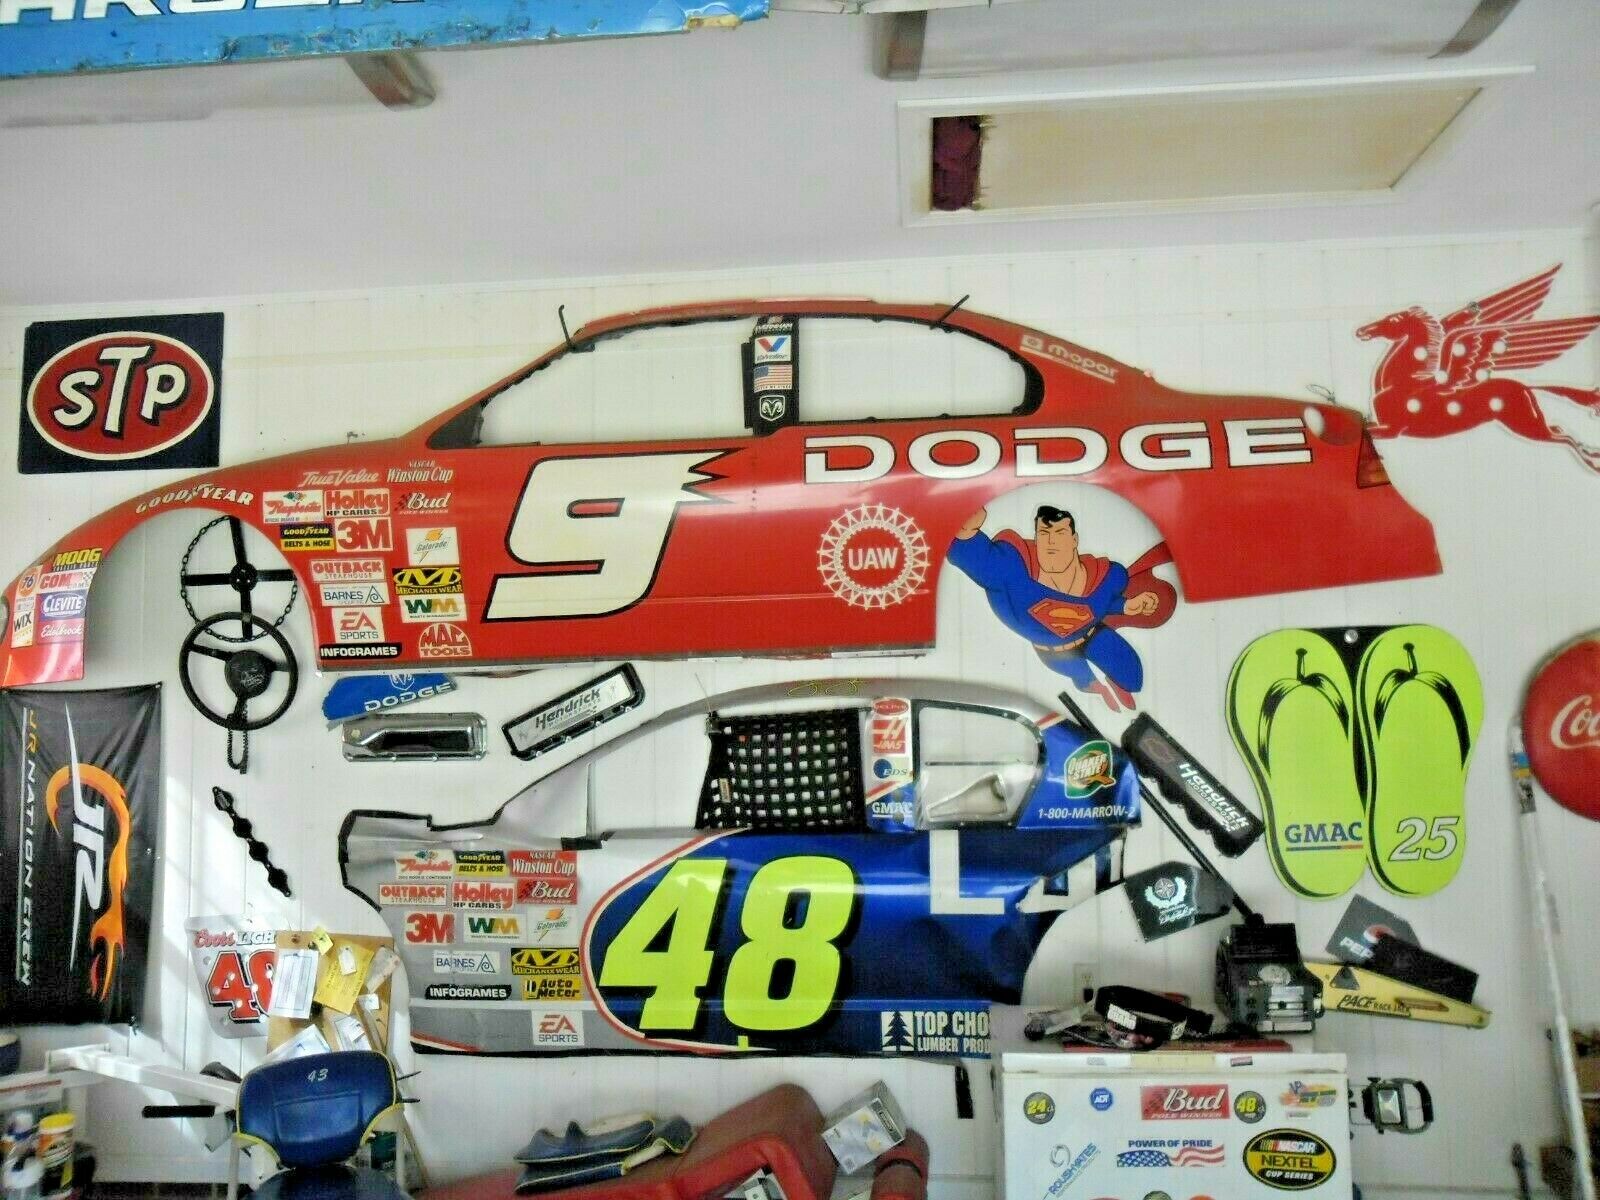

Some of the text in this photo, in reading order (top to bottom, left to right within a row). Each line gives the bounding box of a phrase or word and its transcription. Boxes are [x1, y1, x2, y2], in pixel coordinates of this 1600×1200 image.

[53, 344, 190, 438] STP
[804, 417, 1313, 484] DODGE
[387, 467, 453, 484] Winston Cup
[326, 490, 389, 516] Holley
[408, 492, 451, 509] Bud
[338, 518, 390, 549] 3M
[481, 447, 748, 623] 9
[53, 548, 102, 566] MOOG
[848, 547, 898, 571] UAW
[313, 561, 382, 573] OUTBACK
[323, 591, 364, 601] BARNES
[438, 584, 463, 594] WEAR
[43, 594, 83, 613] CLEVITE
[14, 611, 32, 632] WIX
[340, 611, 377, 631] EA
[340, 631, 379, 641] SPORTS
[320, 646, 398, 657] INFOGRAMES
[421, 648, 471, 656] TOOLS
[365, 682, 452, 712] DODGE
[536, 689, 600, 730] Hendrick
[883, 768, 908, 777] EDS
[1179, 763, 1250, 827] Hendrick
[1038, 806, 1135, 819] 1-800-MARROW-2
[23, 759, 36, 888] NATION
[1284, 821, 1363, 844] GMAC
[1388, 816, 1460, 862] 25
[459, 865, 477, 873] BELTS
[512, 859, 576, 875] Winston Cup
[380, 886, 446, 898] OUTBACK
[453, 882, 514, 909] Holley
[531, 881, 574, 898] Bud
[406, 913, 455, 944] 3M
[468, 917, 520, 935] WM
[194, 928, 236, 949] Coors
[598, 855, 858, 1032] 48
[436, 957, 475, 967] BARNES
[556, 965, 580, 975] WEAR
[430, 987, 507, 998] INFOGRAMES
[540, 979, 573, 989] Auto
[538, 987, 580, 999] Meter
[539, 1014, 577, 1034] EA
[914, 1011, 991, 1036] TOP CHO
[539, 1034, 579, 1043] SPORTS
[917, 1036, 959, 1052] LUMBER
[307, 1068, 329, 1082] 43
[1027, 1098, 1047, 1115] 24
[1094, 1094, 1109, 1104] ADT
[1164, 1087, 1226, 1112] Bud
[1236, 1096, 1257, 1113] 48
[1128, 1139, 1213, 1148] POWER OF PRIDE
[1279, 1140, 1317, 1153] NASCAR
[1261, 1154, 1315, 1169] NEXTEL
[1265, 1170, 1315, 1181] CUP SERIES
